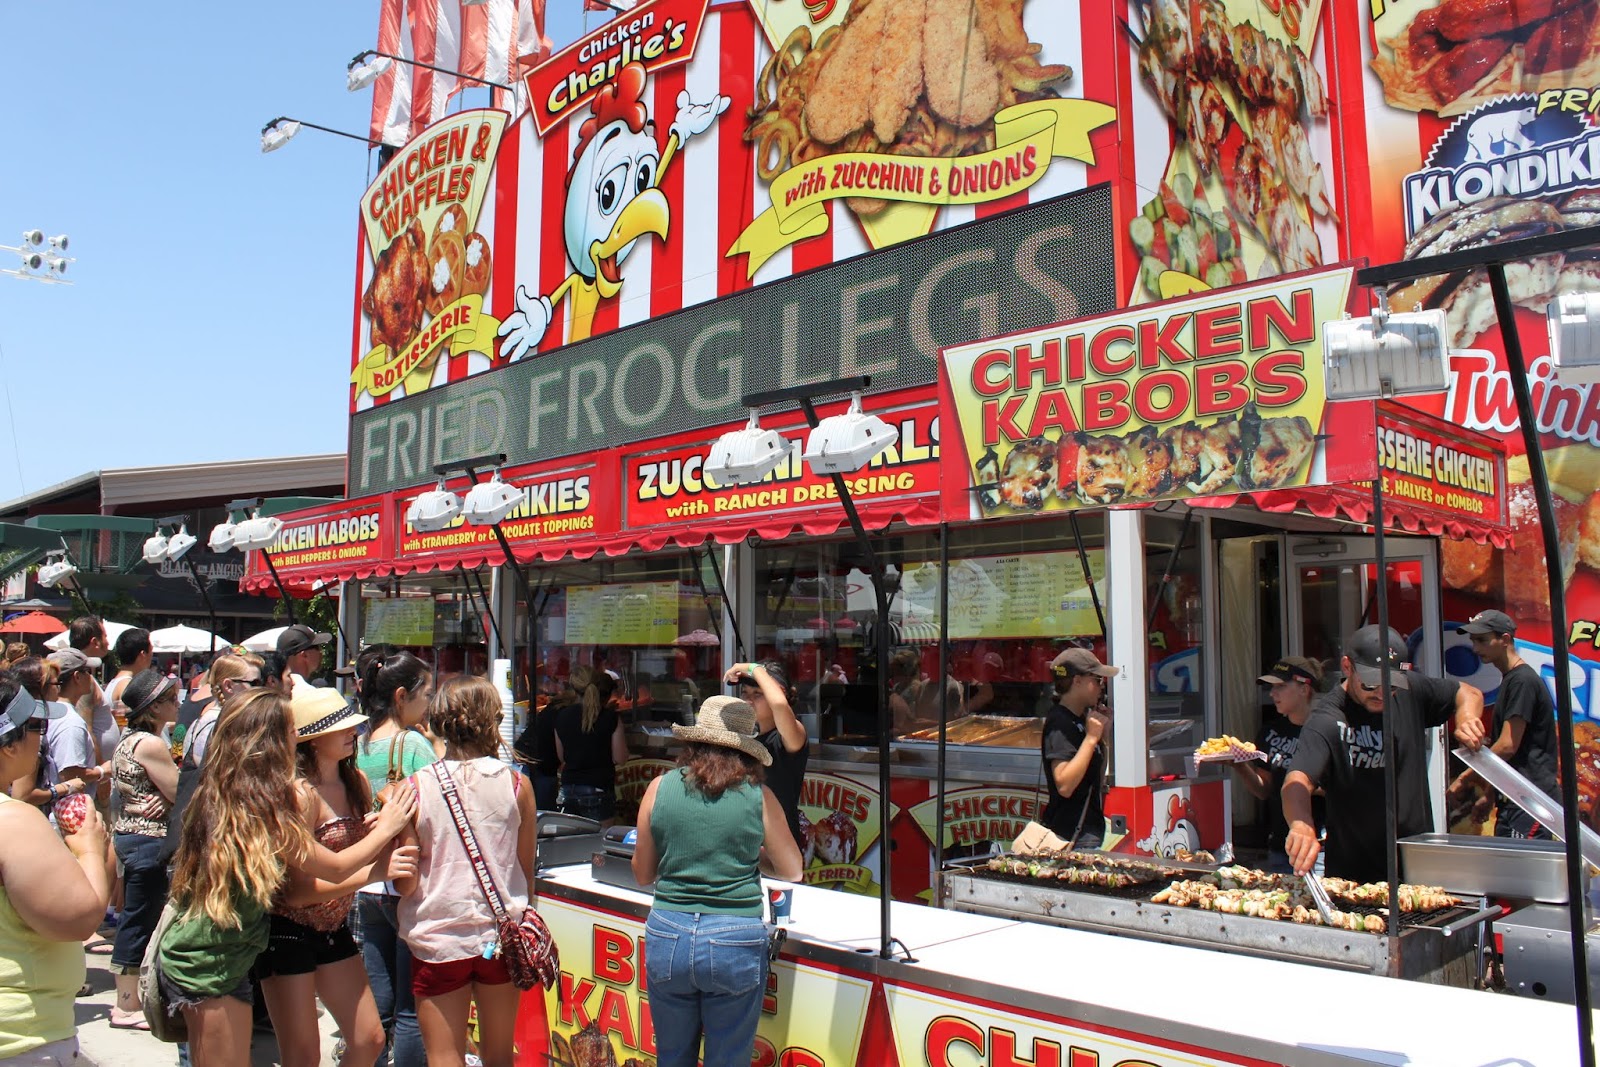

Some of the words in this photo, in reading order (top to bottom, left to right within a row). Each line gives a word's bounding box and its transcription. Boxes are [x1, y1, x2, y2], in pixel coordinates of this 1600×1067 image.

[370, 123, 469, 219] CHICKEN
[471, 122, 491, 162] &
[785, 165, 826, 207] with
[831, 161, 925, 194] ZUCCHINI
[928, 171, 942, 195] &
[949, 145, 1037, 197] ONIONS
[380, 166, 475, 240] WAFFLES
[360, 389, 505, 490] FRIED
[528, 319, 744, 452] FROG
[780, 223, 1079, 392] LEGS
[372, 305, 471, 389] ROTISSERIE
[970, 288, 1316, 398] CHICKEN
[981, 350, 1308, 446] KABOBS
[1434, 445, 1495, 496] CHICKEN
[666, 500, 709, 518] with
[714, 488, 788, 513] RANCH
[1395, 479, 1433, 503] HALVES
[1435, 494, 1445, 505] or
[1447, 492, 1483, 514] COMBOS
[285, 554, 300, 565] BELL
[301, 550, 331, 564] PEPPERS
[332, 550, 337, 560] &
[338, 546, 367, 559] ONIONS
[318, 513, 379, 547] KABOBS
[403, 539, 420, 551] with
[422, 531, 476, 549] STRAWBERRY
[478, 533, 487, 542] or
[489, 523, 541, 540] COCOLATE
[543, 515, 594, 534] TOPPINGS
[208, 562, 244, 577] ANGUS
[819, 867, 863, 881] FRIED!
